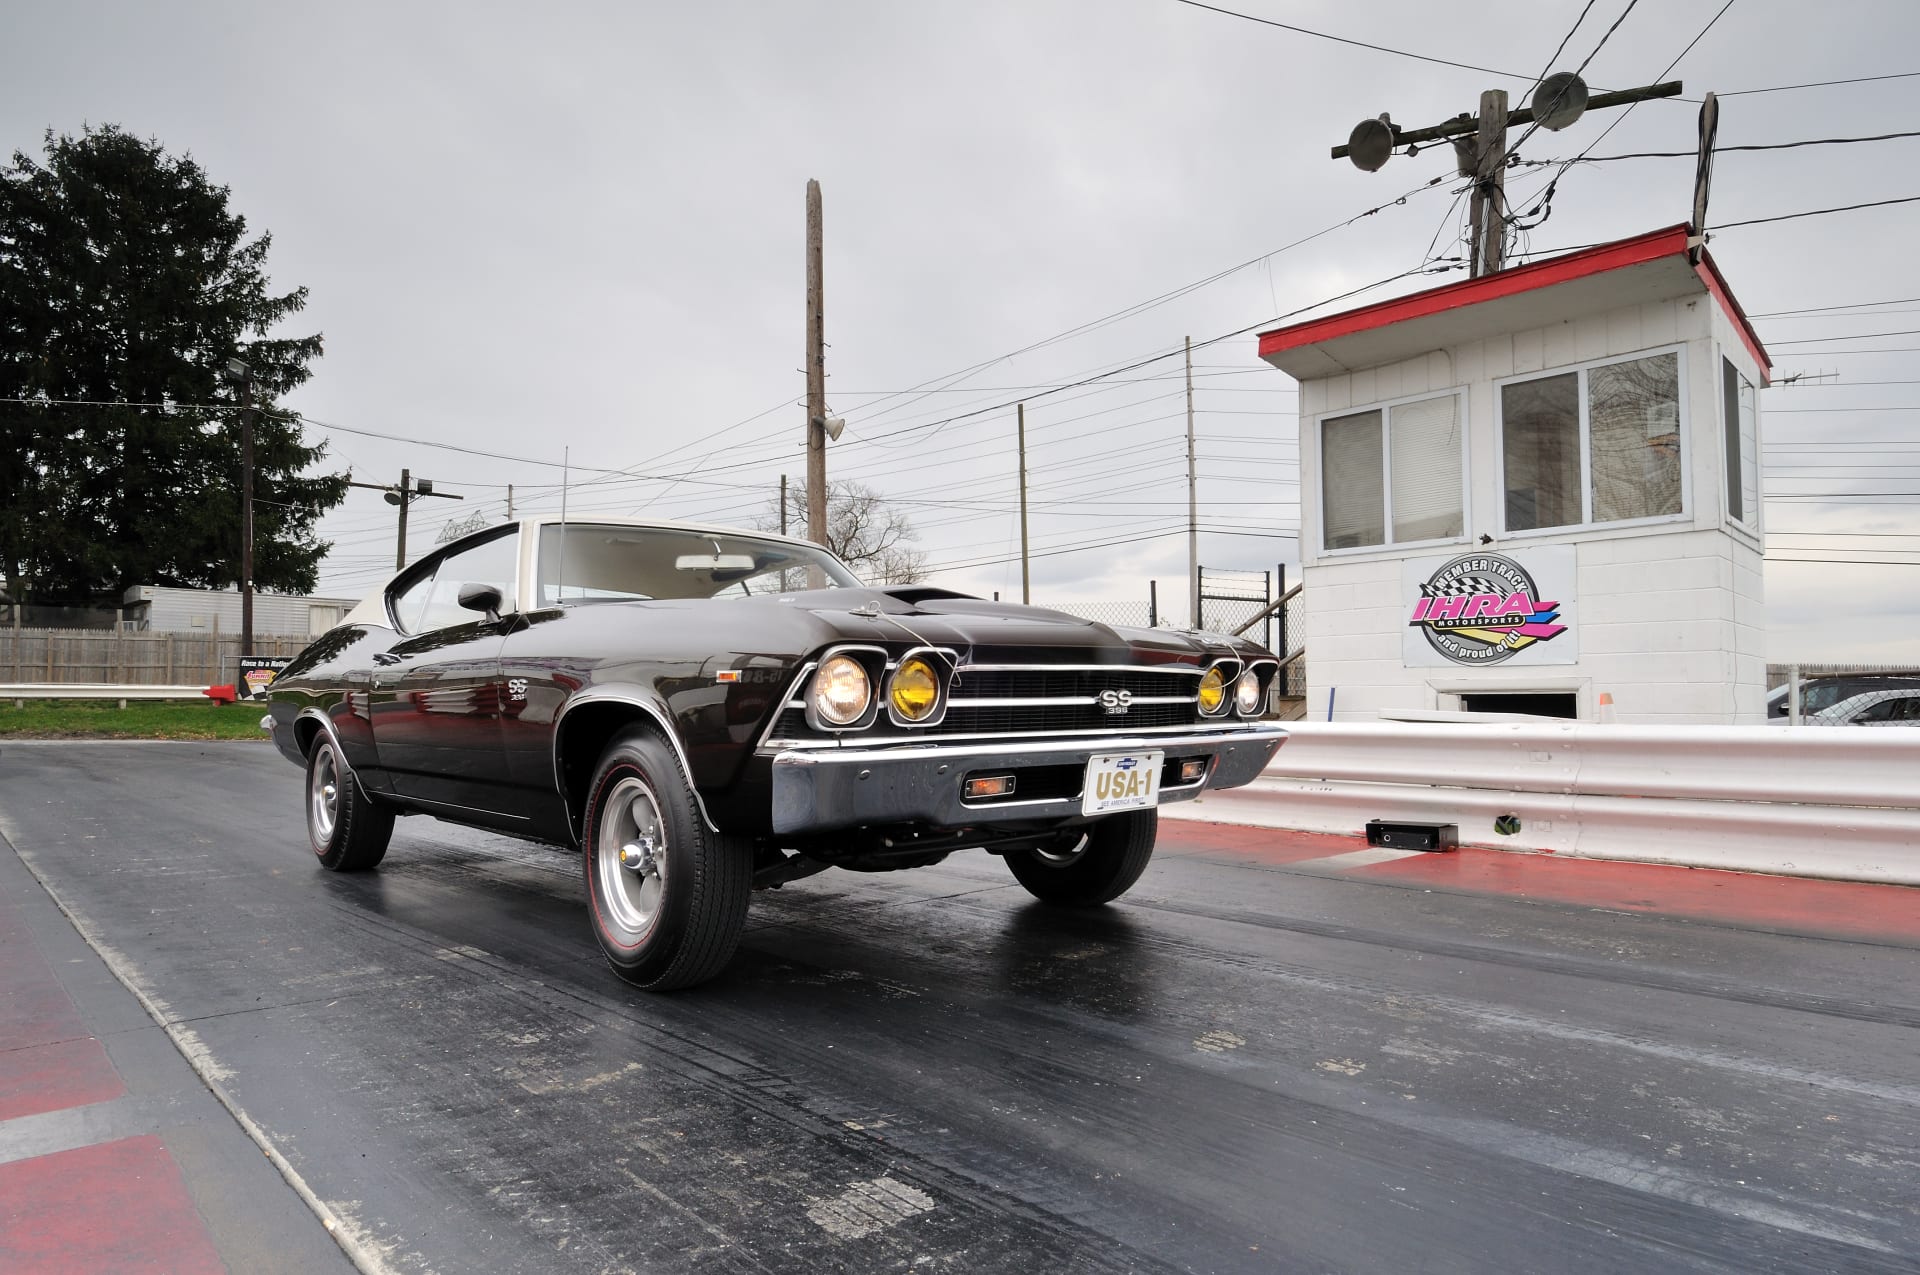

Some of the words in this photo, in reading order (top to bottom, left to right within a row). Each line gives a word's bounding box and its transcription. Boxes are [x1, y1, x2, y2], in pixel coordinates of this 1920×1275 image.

[1435, 559, 1488, 590] MEMBER
[1491, 560, 1528, 592] TRACK
[1411, 592, 1535, 621] IHRA
[1438, 617, 1519, 626] MOTORSPORTS
[1438, 634, 1459, 652] and
[1458, 646, 1493, 658] proud
[1496, 639, 1509, 653] of
[1505, 629, 1521, 645] it!
[508, 678, 528, 694] SS
[1101, 690, 1132, 707] SS
[1096, 769, 1153, 800] USA-1
